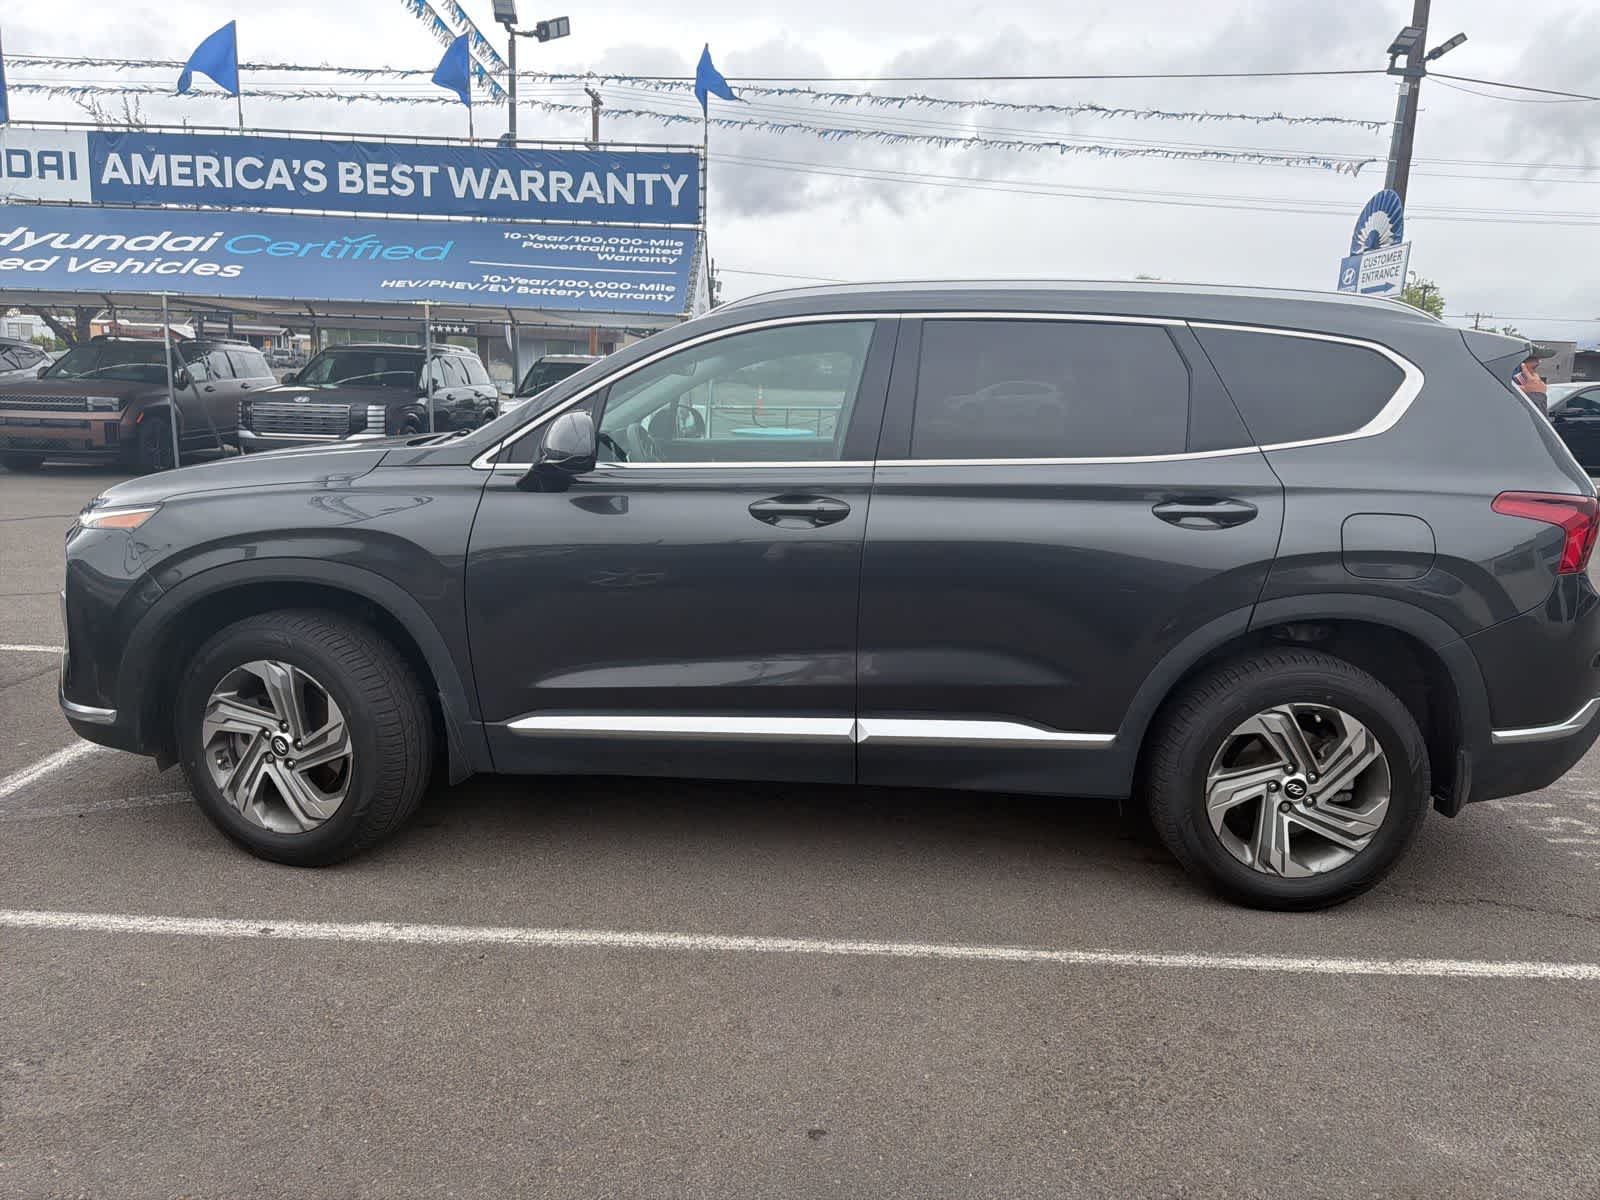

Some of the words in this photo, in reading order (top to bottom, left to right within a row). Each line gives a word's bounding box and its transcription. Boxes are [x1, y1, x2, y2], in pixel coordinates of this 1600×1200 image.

[0, 149, 78, 181] DAI
[101, 152, 328, 193] AMERICA'S
[338, 162, 440, 198] BEST
[447, 166, 689, 206] WARRANTY
[224, 233, 455, 261] Certified
[503, 232, 684, 247] 10-Year/100,000-Mile
[522, 241, 615, 253] Powertrain
[619, 246, 683, 256] Limited
[67, 256, 244, 278] Vehicles
[597, 253, 678, 265] Warranty
[1363, 249, 1403, 269] CUSTOMER
[481, 274, 676, 292] 10-Year/100,000-Mile
[1361, 265, 1401, 283] ENTRANCE
[380, 279, 514, 293] HEV/PHEV/EV
[517, 285, 585, 298] Battery
[585, 289, 675, 302] Warranty
